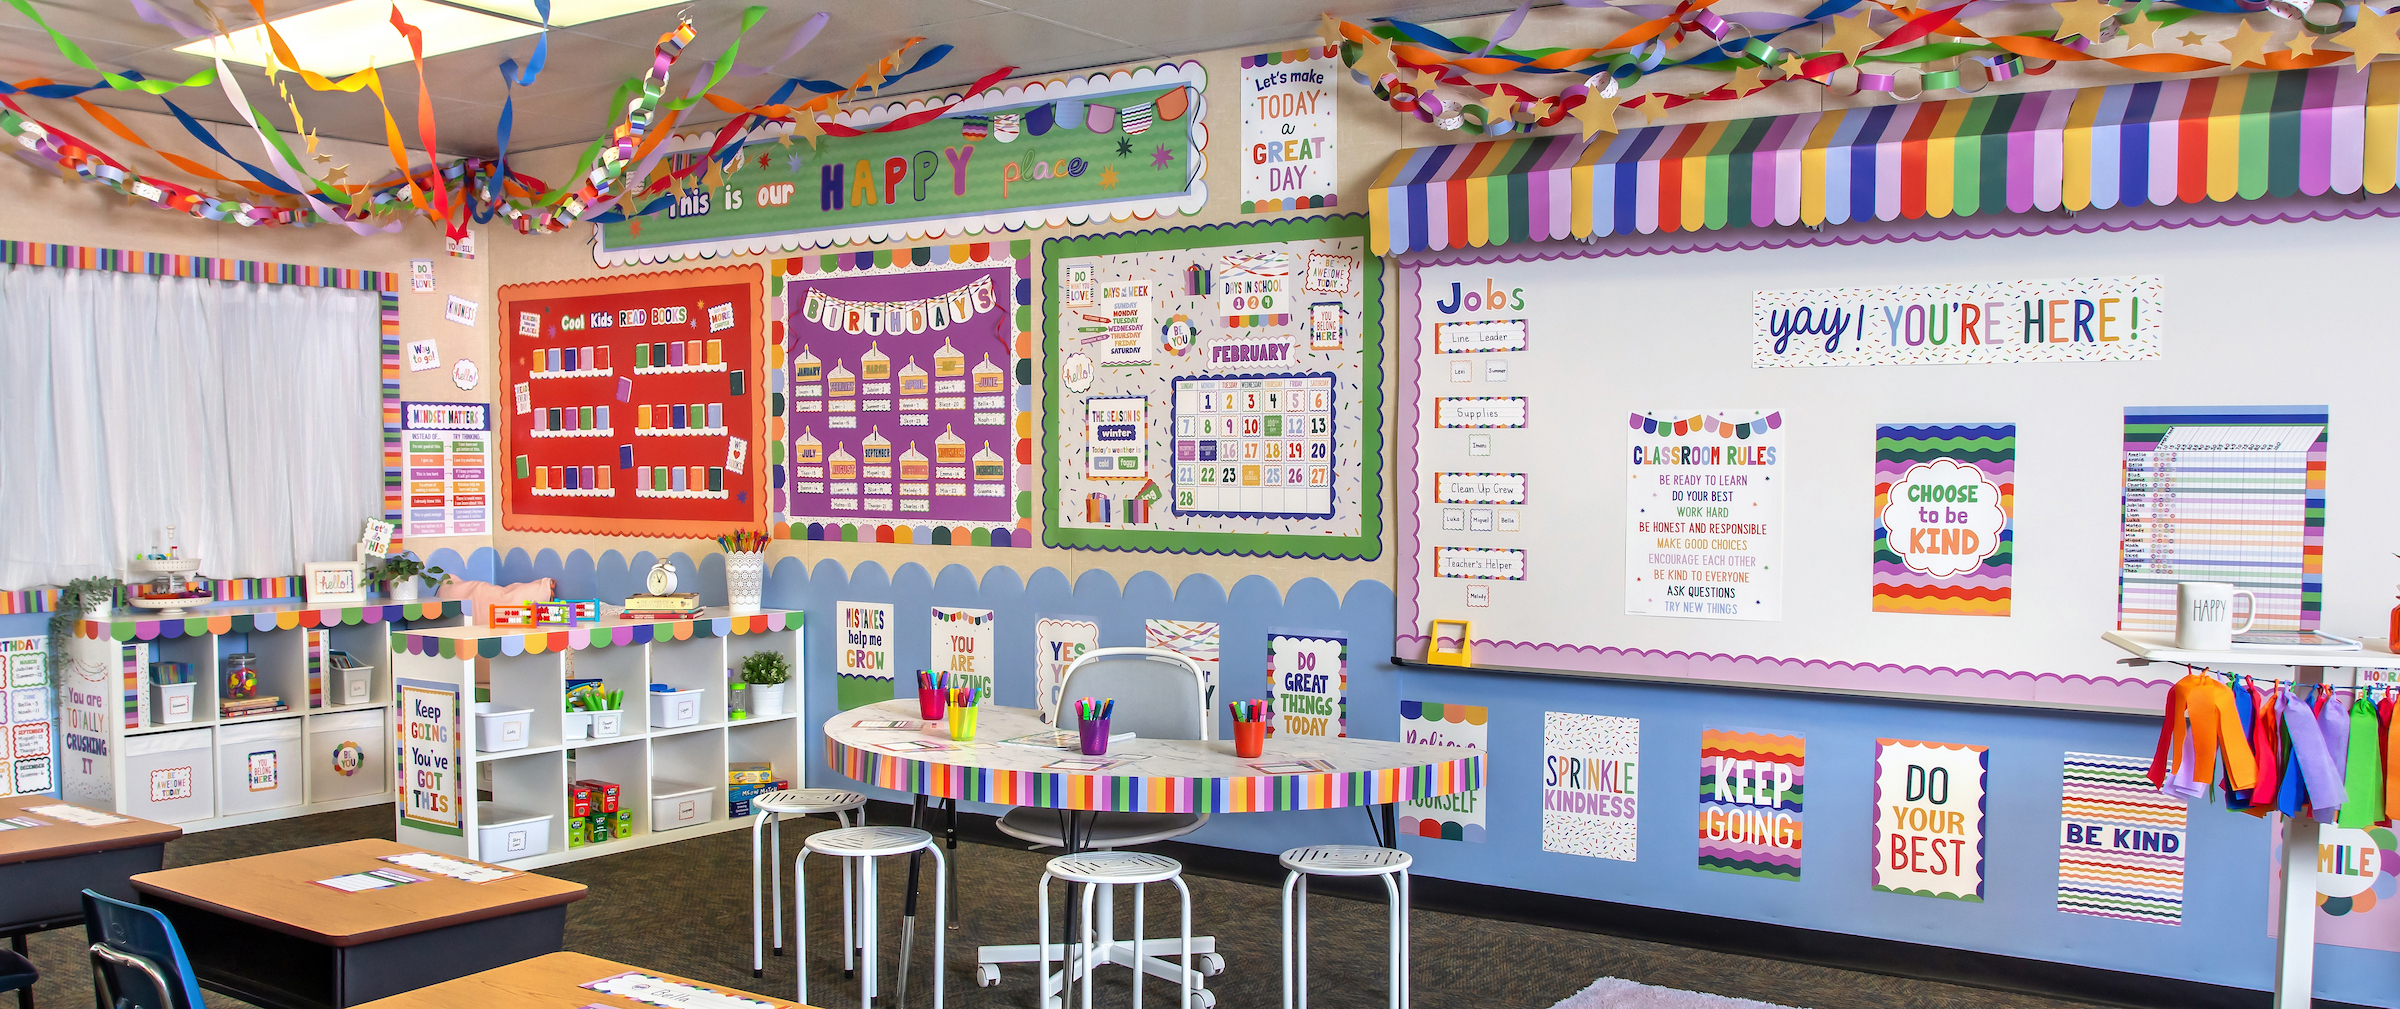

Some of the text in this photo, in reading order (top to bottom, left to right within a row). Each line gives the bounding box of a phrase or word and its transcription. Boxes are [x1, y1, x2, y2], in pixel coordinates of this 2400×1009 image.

[1255, 69, 1324, 92] Let's make
[1257, 89, 1320, 120] TODAY
[1282, 123, 1296, 134] a
[1253, 137, 1325, 164] GREAT
[725, 184, 742, 210] is
[757, 182, 795, 208] our
[820, 145, 975, 212] HAPPY
[1003, 149, 1088, 198] place
[1270, 164, 1307, 192] DAY
[418, 264, 427, 272] DO
[1313, 269, 1344, 279] AWESOME
[416, 280, 432, 288] LOVE
[1075, 271, 1086, 282] DO
[1318, 279, 1337, 288] TODAY
[1104, 285, 1148, 298] DAYS WEEK
[1226, 279, 1282, 294] DAYS IN SCHOOL
[1071, 291, 1089, 300] LOVE
[1437, 278, 1525, 314] Jobs
[448, 302, 474, 320] KINDNESS
[712, 312, 731, 323] MORE
[807, 288, 990, 332] BIRTHDAYS
[1321, 311, 1332, 320] YOU
[561, 308, 686, 332] Cool Kids READ BOOKS
[1317, 321, 1336, 331] BELONG
[1770, 296, 2138, 354] yay! YOU'RE HERE!
[1108, 324, 1144, 332] WEDNESDAY
[1174, 326, 1183, 336] BE
[1172, 335, 1188, 346] YOU
[1316, 332, 1337, 341] HERE
[1452, 332, 1508, 343] Line Leader
[413, 351, 435, 364] to go!
[414, 345, 430, 355] Way
[1212, 343, 1290, 363] FEBRUARY
[454, 371, 476, 382] hello!
[797, 366, 820, 377] JANUARY
[1065, 363, 1090, 384] hello!
[904, 379, 925, 390] APRIL
[978, 376, 997, 387] JUNE
[414, 410, 478, 424] MINDSET MATTERS
[1092, 410, 1141, 422] THE SEASON IS
[1457, 408, 1499, 419] Supplies
[1311, 418, 1326, 433] 13
[1102, 429, 1132, 438] winter
[802, 449, 816, 458] JULY
[865, 448, 890, 458] SEPTEMBER
[1092, 446, 1111, 455] Today's
[1311, 443, 1326, 458] 20
[1633, 446, 1776, 465] CLASSROOM RULES
[1120, 458, 1136, 468] foggy
[1222, 468, 1236, 482] 23
[1659, 475, 1748, 486] BE READY TO LEARN
[1451, 484, 1514, 495] Clean Up Crew
[1673, 491, 1733, 502] DO YOUR BEST
[1907, 484, 1978, 504] CHOOSE
[1179, 491, 1193, 506] 28
[1677, 507, 1729, 517] WORK HARD
[1919, 507, 1968, 525] to be
[371, 523, 388, 534] Let's
[1639, 522, 1767, 535] BE HONEST AND RESPONSIBLE
[365, 539, 385, 553] THIS
[1657, 538, 1748, 550] MAKE GOOD CHOICES
[1909, 527, 1979, 556] KIND
[1446, 558, 1512, 572] Teacher's Helper
[1648, 553, 1756, 567] ENCOURAGE EACH OTHER
[319, 574, 349, 590] hello!
[1654, 569, 1749, 583] BE KIND TO EVERYONE
[1470, 593, 1487, 601] Melody
[1667, 586, 1735, 598] ASK QUESTIONS
[1665, 601, 1737, 614] TRY NEW THINGS
[2193, 599, 2226, 622] HAPPY
[846, 608, 884, 630] MISTAKES
[848, 630, 882, 648] help me
[951, 635, 974, 654] YOU
[1051, 641, 1086, 661] YES
[846, 650, 884, 670] GROW
[951, 655, 974, 672] ARE
[1297, 652, 1316, 671] DO
[1285, 673, 1328, 694] GREAT
[68, 688, 102, 708] You are
[1280, 694, 1333, 715] THINGS
[415, 698, 441, 723] Keep
[67, 708, 104, 733] TOTALLY
[1284, 715, 1328, 736] TODAY
[411, 722, 447, 743] GOING
[66, 733, 107, 756] CRUSHING
[412, 747, 448, 769] You've
[81, 758, 92, 775] IT
[253, 774, 272, 784] HERE
[417, 769, 442, 790] GOT
[1546, 755, 1635, 794] SPRINKLE
[1714, 756, 1793, 808] KEEP
[157, 779, 186, 789] AWESOME
[1906, 764, 1949, 805] DO
[413, 789, 449, 813] THIS
[1408, 788, 1477, 813] URSELF
[1545, 788, 1635, 819] KINDNESS
[1706, 806, 1794, 849] GOING
[1892, 806, 1965, 835] YOUR
[2066, 823, 2179, 853] BE KIND
[1891, 834, 1966, 877] BEST
[2318, 844, 2374, 877] MILE
[651, 989, 690, 1003] Bella
